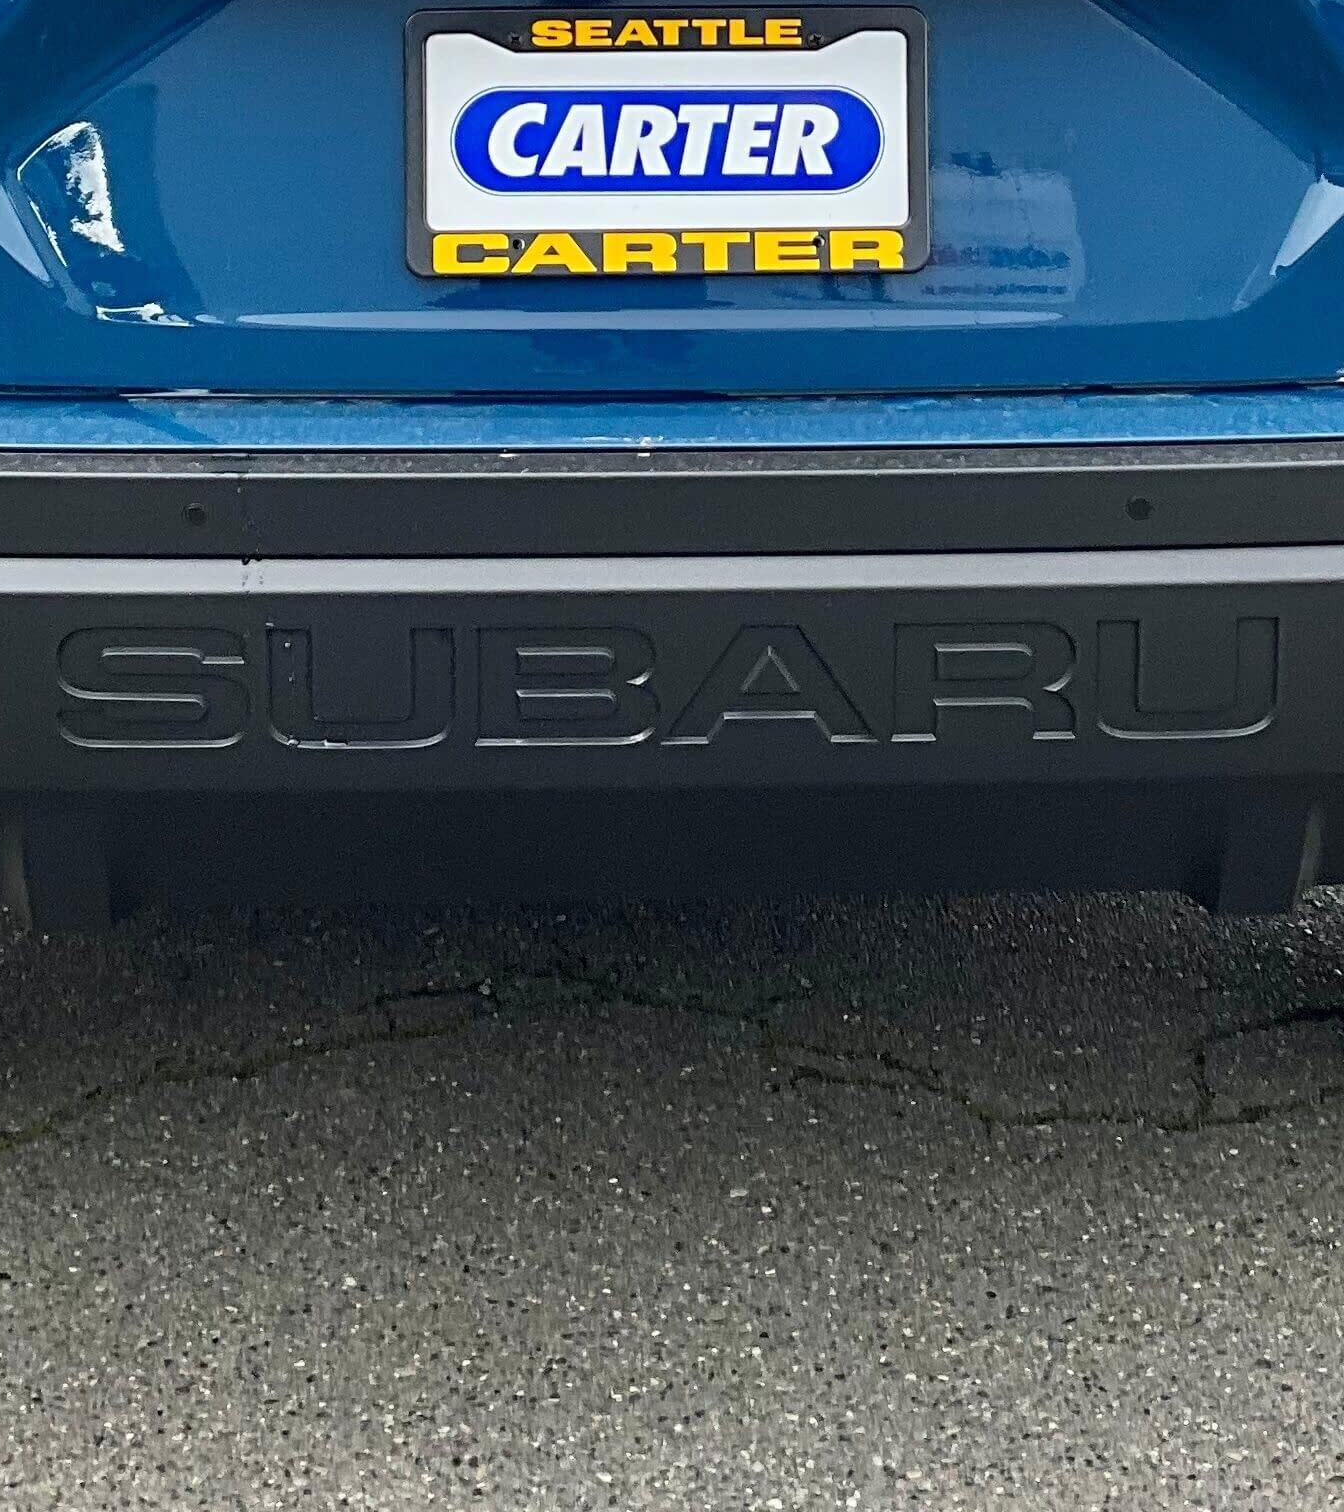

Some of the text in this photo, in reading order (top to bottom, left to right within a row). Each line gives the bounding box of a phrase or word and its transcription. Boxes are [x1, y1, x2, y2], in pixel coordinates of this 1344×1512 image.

[531, 19, 803, 47] SEATTLE
[487, 102, 840, 177] CARTER
[432, 231, 905, 274] CARTER
[58, 617, 1279, 749] SUBARU
